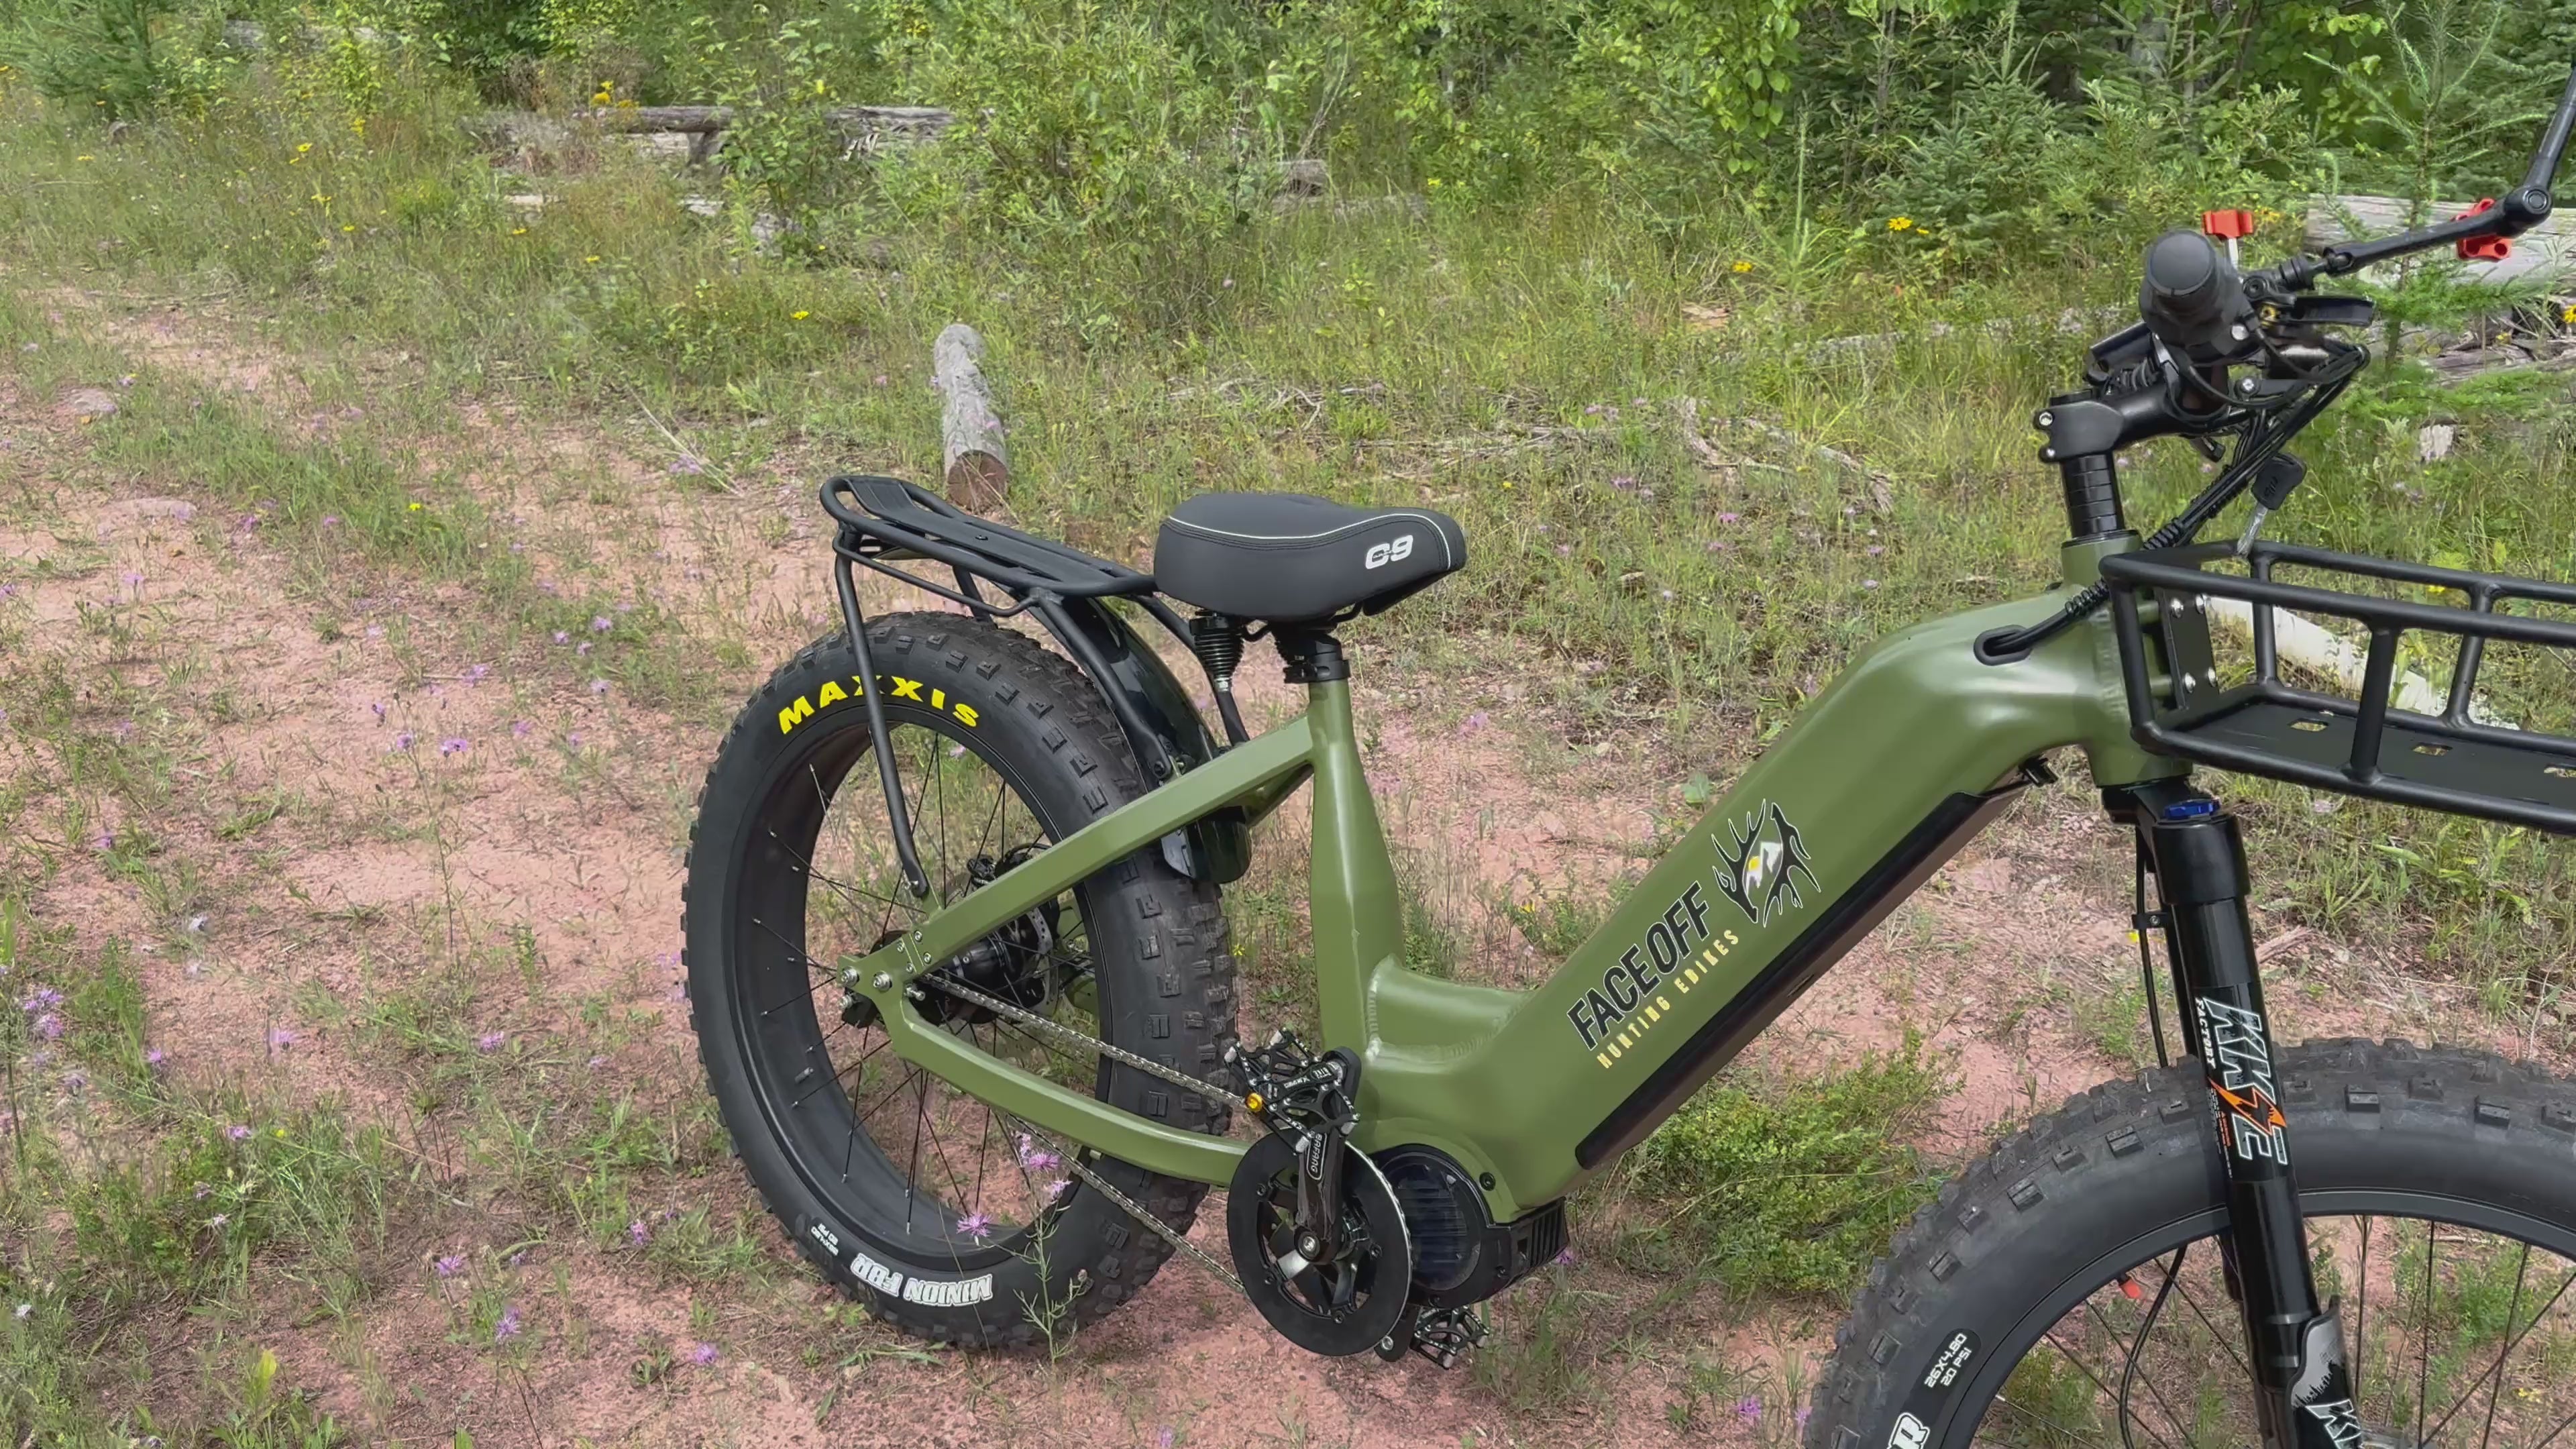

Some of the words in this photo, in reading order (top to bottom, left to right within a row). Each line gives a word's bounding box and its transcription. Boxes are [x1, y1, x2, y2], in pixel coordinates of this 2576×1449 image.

[1365, 535, 1413, 569] C9
[1566, 943, 1662, 1051] FACE
[1646, 880, 1710, 975] OFF
[1597, 996, 1670, 1069] HUNTING
[1674, 929, 1739, 994] EBIKES
[2195, 997, 2216, 1069] FACTORY
[903, 1274, 994, 1307] MINION
[1924, 1333, 1968, 1388] 26X4.80
[1940, 1368, 1957, 1387] 20
[1953, 1347, 1972, 1368] PSI
[2304, 1399, 2362, 1449] K
